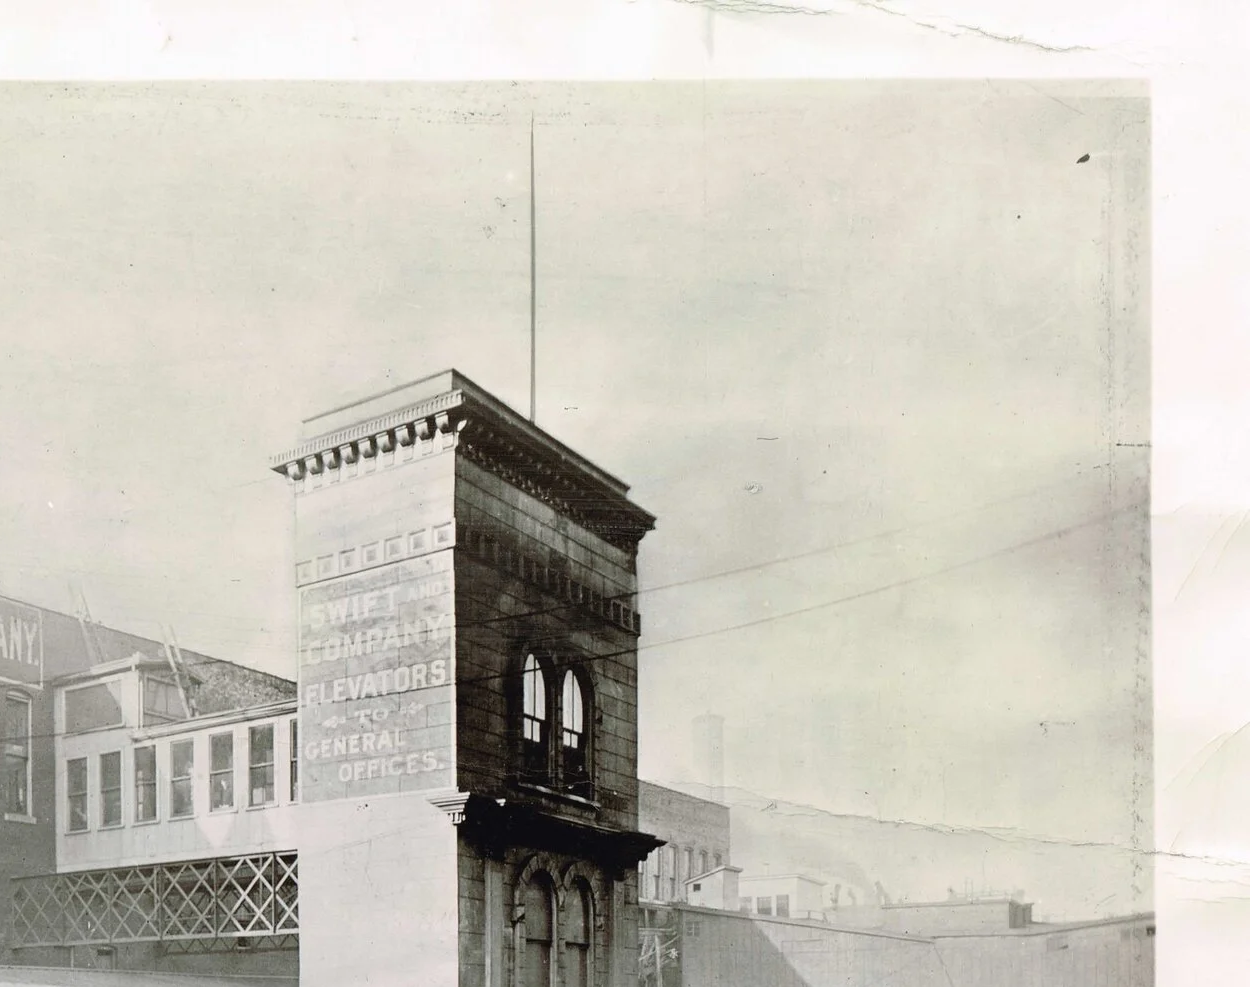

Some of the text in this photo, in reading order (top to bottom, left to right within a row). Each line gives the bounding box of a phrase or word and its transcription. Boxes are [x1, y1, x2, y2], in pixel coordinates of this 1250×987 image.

[310, 586, 402, 628] SWIFT
[306, 659, 447, 706] ELEVATORS
[355, 709, 389, 728] TO
[305, 730, 406, 761] GENERAL
[338, 753, 446, 782] OFFICES.
